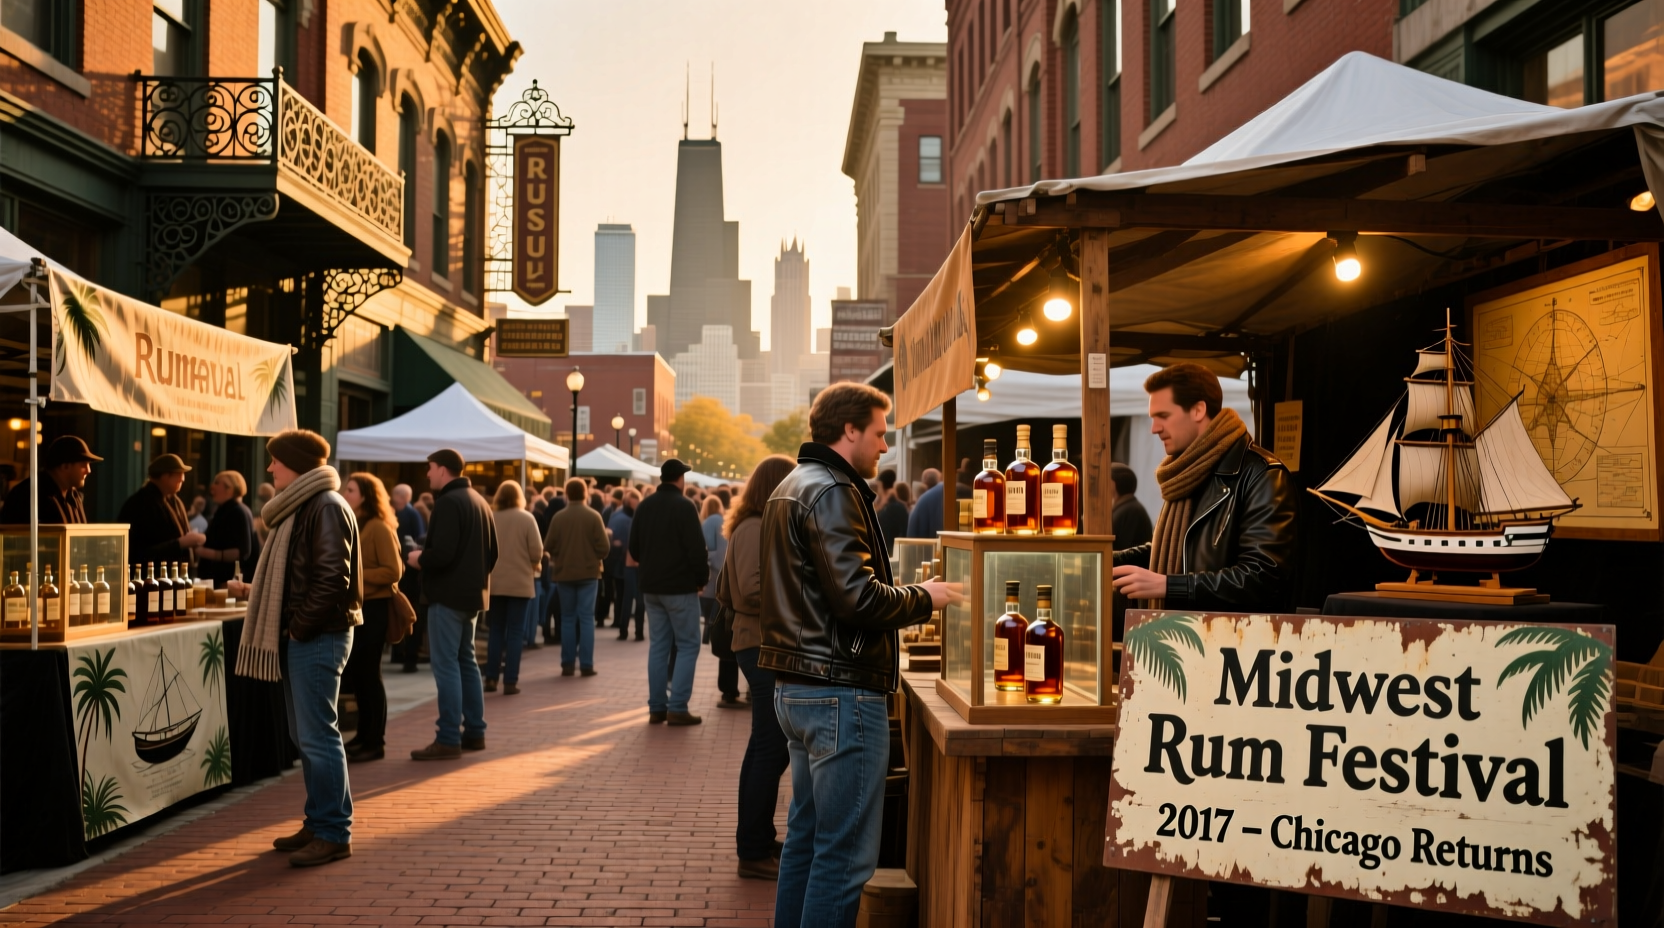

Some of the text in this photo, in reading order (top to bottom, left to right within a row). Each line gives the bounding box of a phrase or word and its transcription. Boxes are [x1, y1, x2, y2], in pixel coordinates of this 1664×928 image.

[1213, 647, 1482, 721] Midwest
[1143, 712, 1570, 809] Rum Festival
[1156, 802, 1235, 843] 2017
[1270, 814, 1402, 870] Chicago
[1410, 827, 1554, 878] Returns
